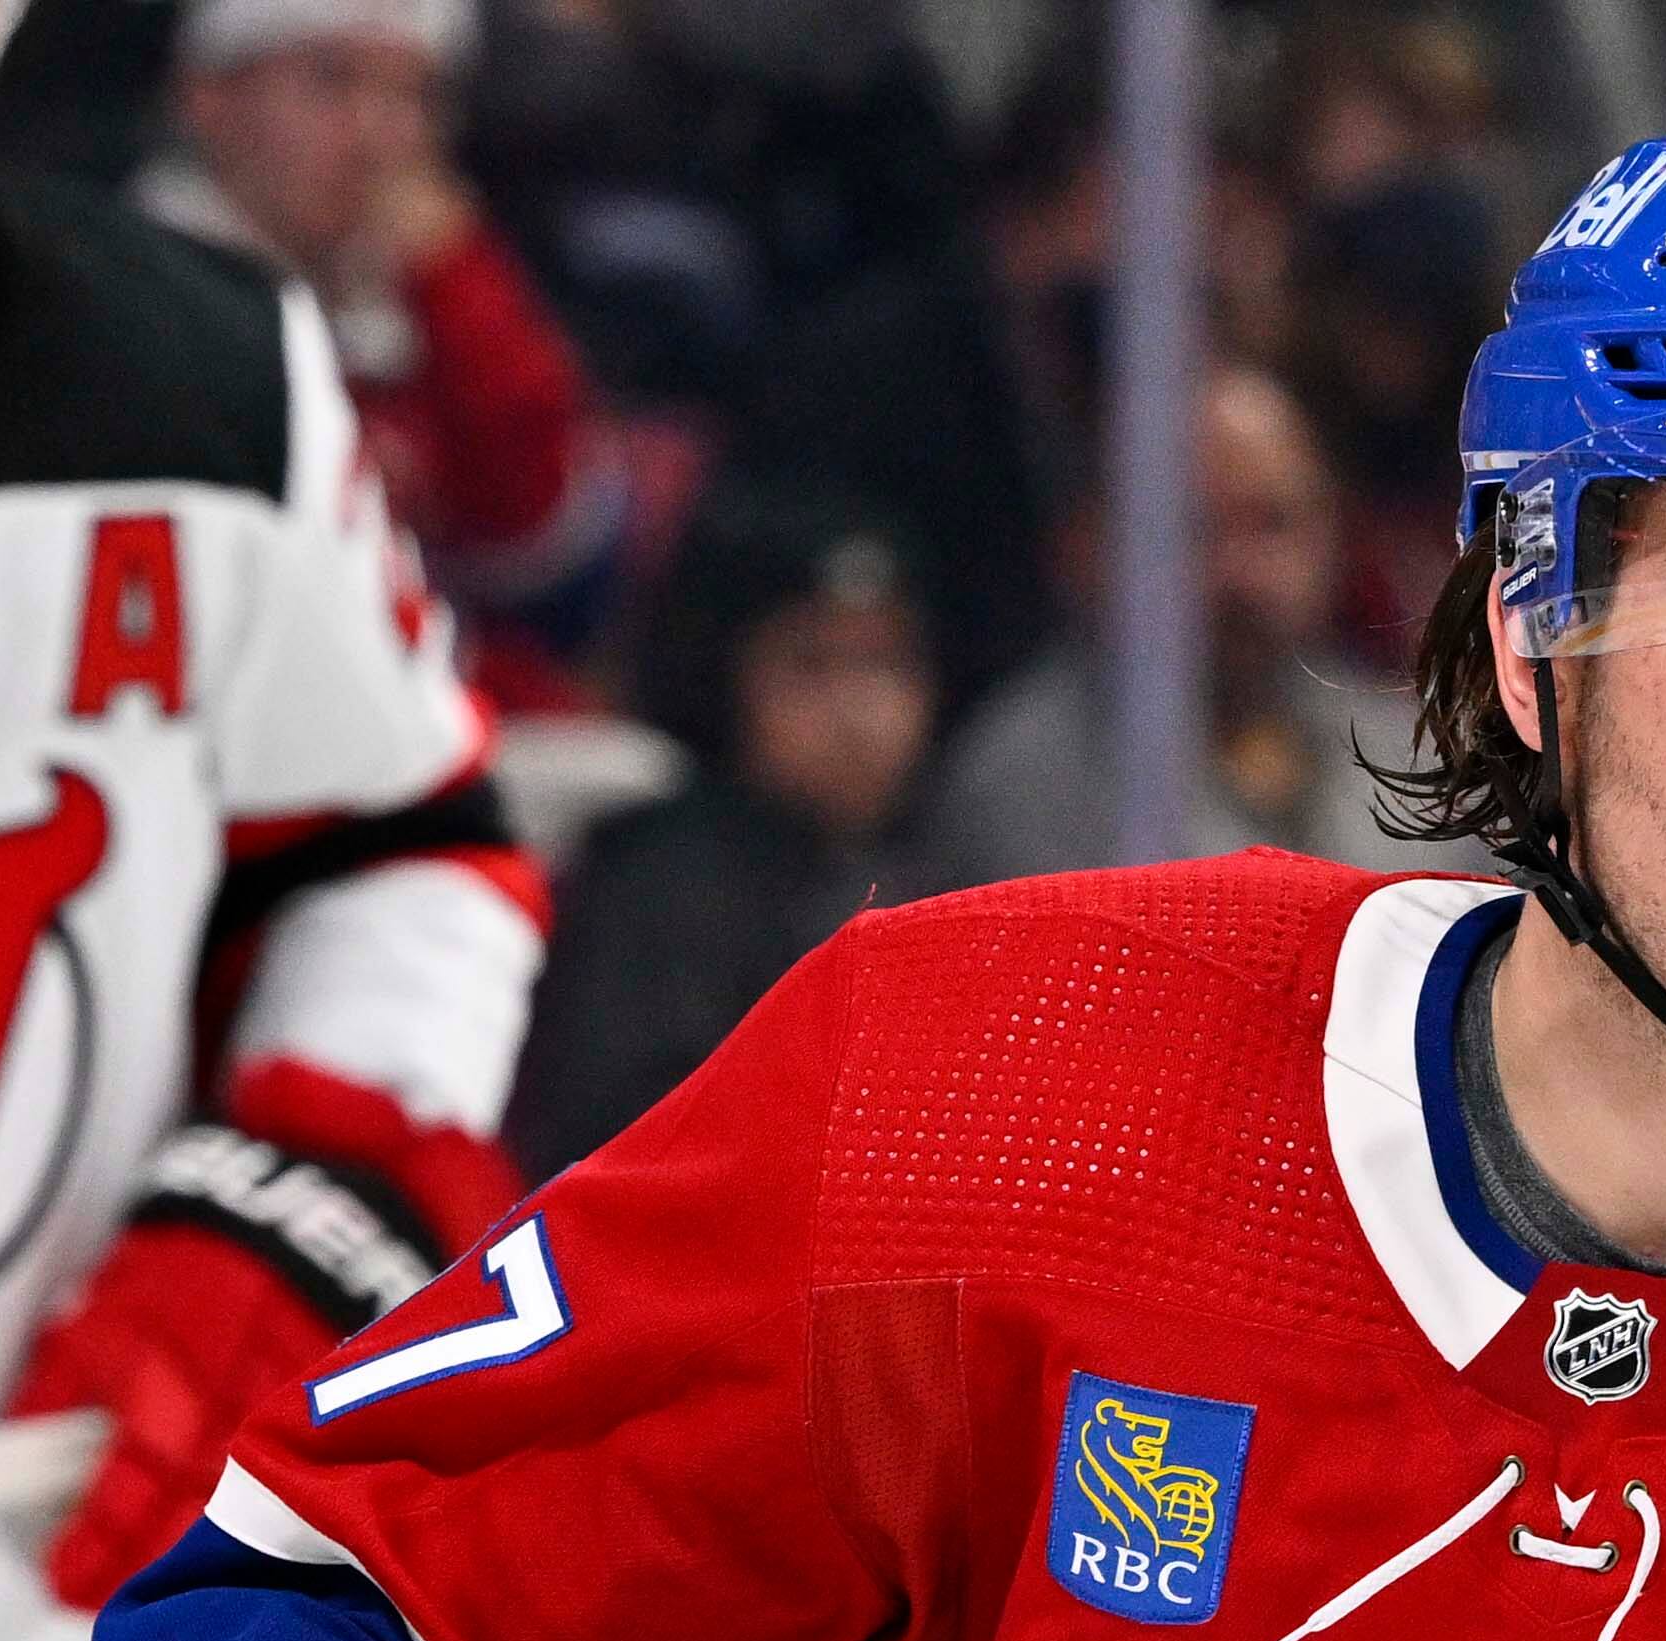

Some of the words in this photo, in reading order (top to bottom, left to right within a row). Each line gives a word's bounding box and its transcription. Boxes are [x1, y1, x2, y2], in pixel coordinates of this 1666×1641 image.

[72, 513, 186, 720] A
[1502, 567, 1537, 600] BAUER
[301, 1210, 574, 1428] 7
[1568, 1320, 1634, 1374] LNH
[1071, 1532, 1198, 1604] RBC
